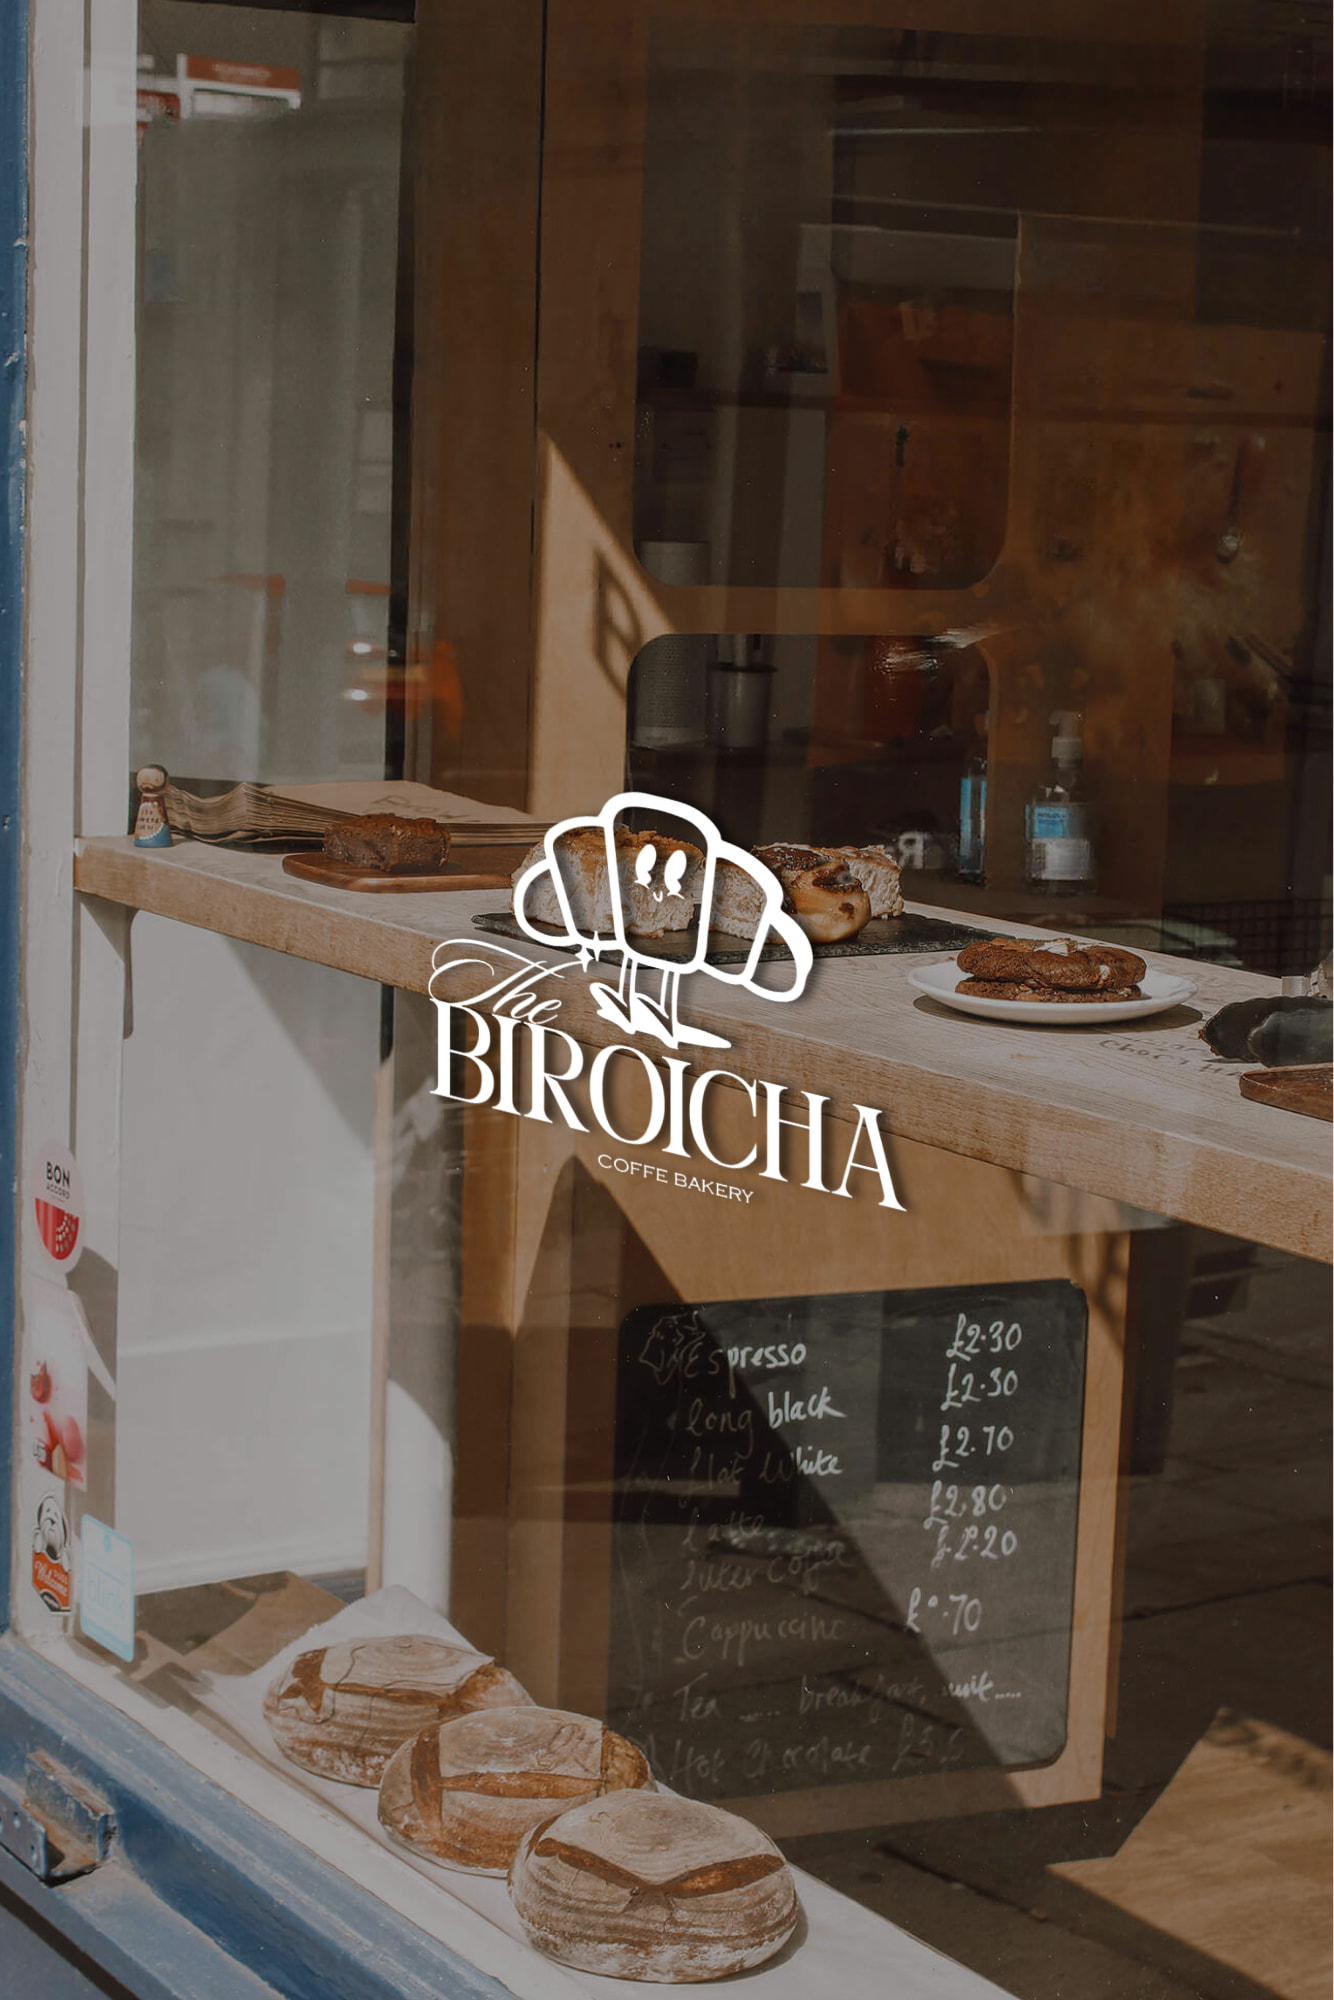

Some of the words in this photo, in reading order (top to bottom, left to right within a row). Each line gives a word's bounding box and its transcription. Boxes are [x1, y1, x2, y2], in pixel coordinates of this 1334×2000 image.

[428, 938, 583, 1025] The
[429, 998, 907, 1212] BIROICHA
[46, 1161, 71, 1188] BON
[597, 1153, 669, 1185] COFFE
[673, 1171, 754, 1204] BAKERY
[684, 1342, 807, 1400] Espresso
[945, 1312, 1023, 1362] £2.30
[767, 1385, 848, 1430] black
[940, 1362, 1018, 1412] £2.30
[931, 1424, 1014, 1473] £2.70
